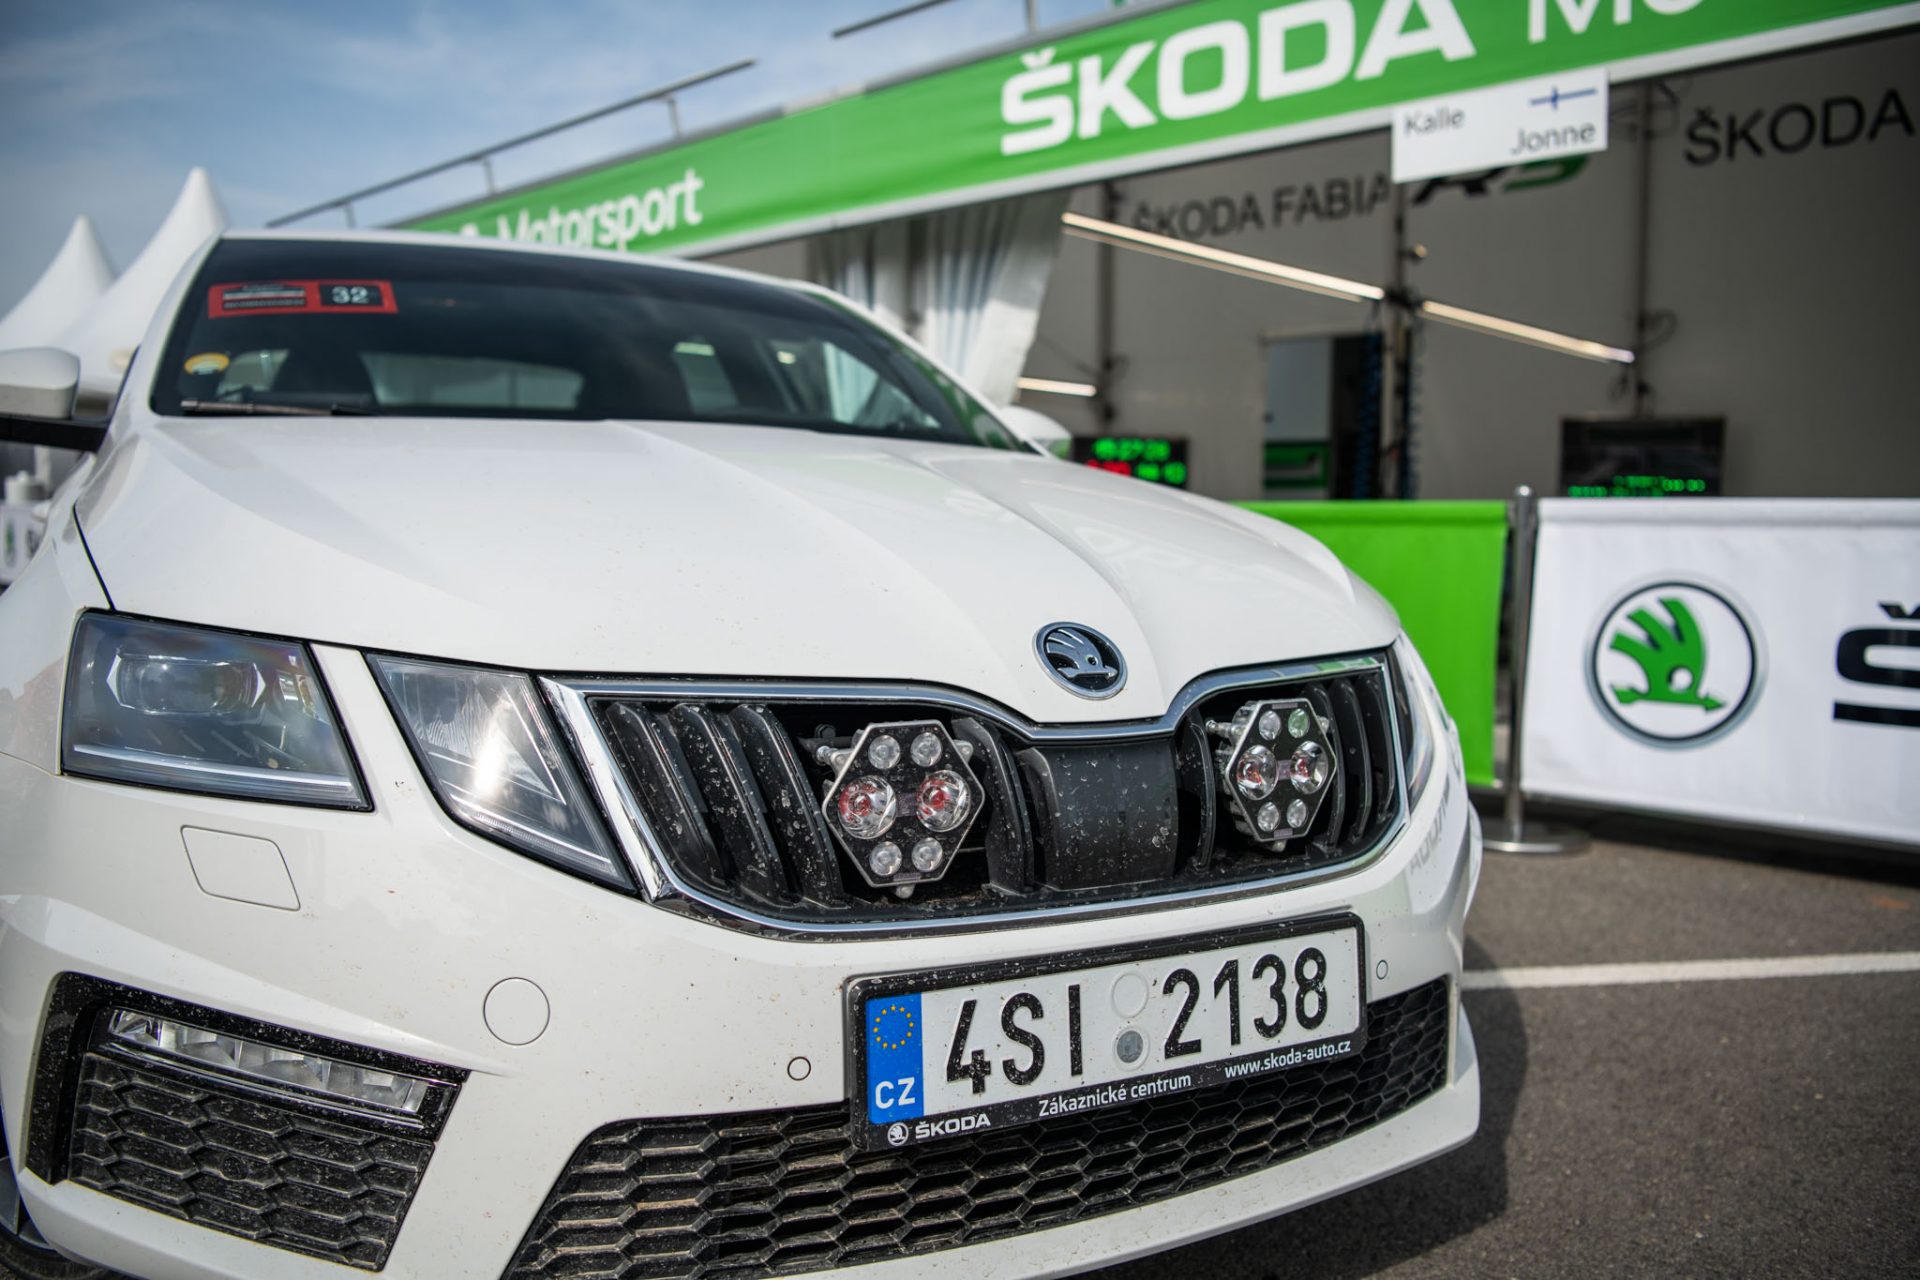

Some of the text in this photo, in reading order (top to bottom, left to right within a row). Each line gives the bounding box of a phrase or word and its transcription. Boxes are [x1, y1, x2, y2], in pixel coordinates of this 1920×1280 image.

[1001, 0, 1477, 156] ŠKODA
[1404, 107, 1465, 135] Kalle
[1511, 121, 1597, 156] Jonne
[1685, 88, 1917, 166] ŠKODA
[331, 286, 368, 304] 32
[946, 947, 1328, 1094] 4SI 2138
[1223, 1041, 1352, 1078] www.skoda-auto.cz
[874, 1076, 916, 1110] CZ
[1038, 1073, 1192, 1117] Zákaznické centrum
[915, 1112, 992, 1140] ŠKODA
